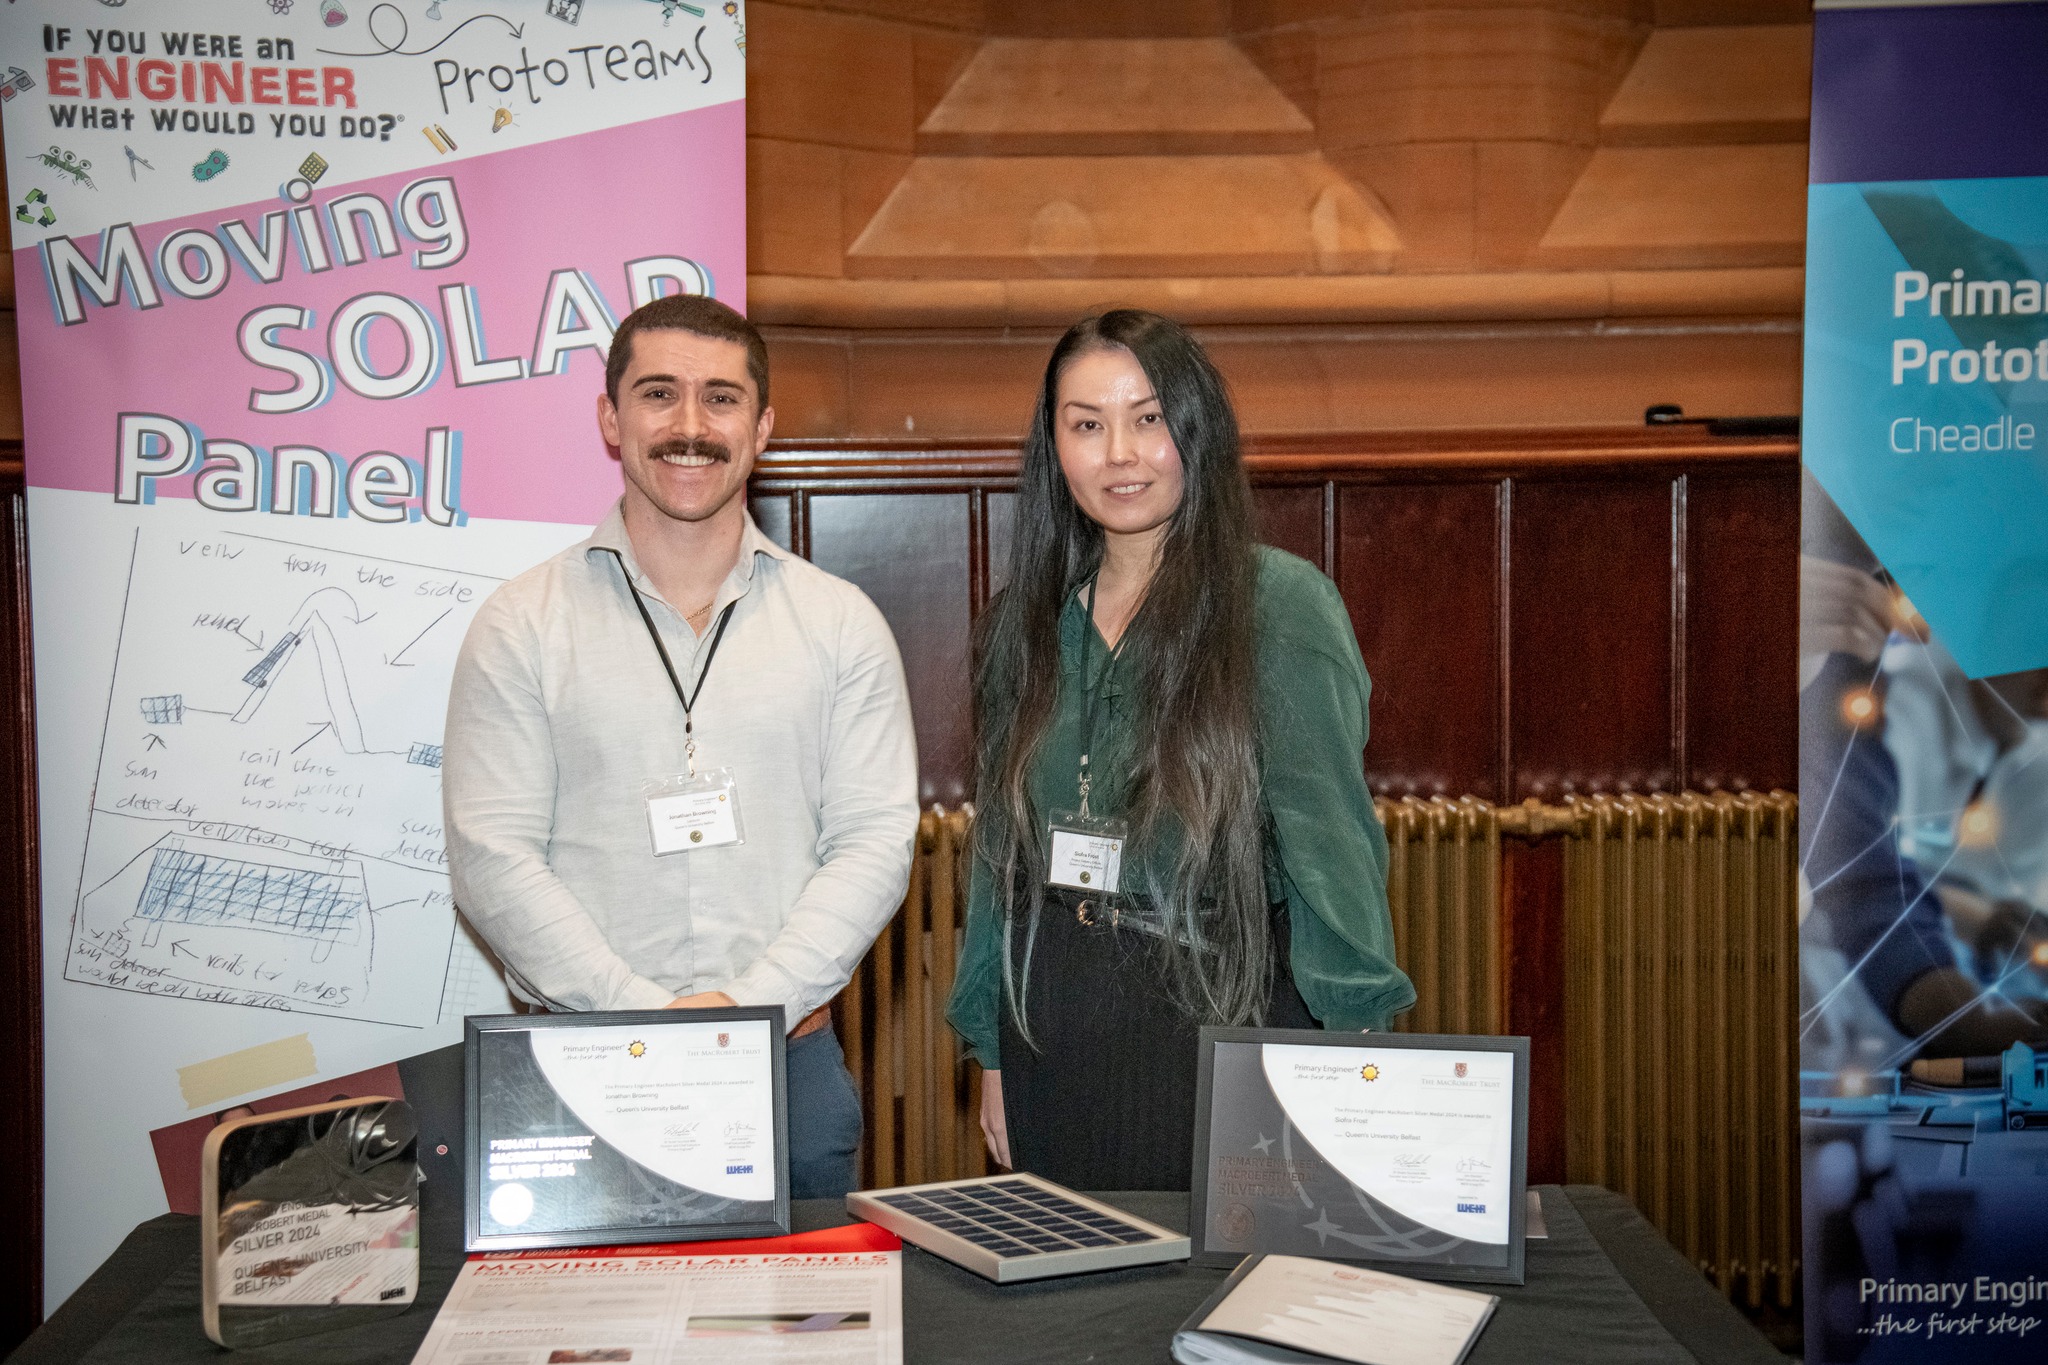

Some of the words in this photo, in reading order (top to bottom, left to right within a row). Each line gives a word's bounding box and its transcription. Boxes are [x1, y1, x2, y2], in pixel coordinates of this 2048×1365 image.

[43, 24, 72, 52] IF
[86, 28, 146, 54] YOU
[161, 31, 244, 58] WERE
[256, 37, 295, 60] an
[46, 56, 358, 109] ENGINEER
[151, 107, 256, 135] WOULD
[270, 112, 326, 138] YOU
[38, 176, 470, 325] Moving
[1890, 415, 2035, 453] Cheadle
[113, 412, 470, 528] Panel
[283, 554, 327, 577] from
[357, 565, 397, 588] the
[414, 581, 474, 603] side
[563, 1045, 590, 1054] Primary
[1294, 1063, 1321, 1073] Primary
[1323, 1065, 1355, 1074] Engineer
[1345, 1130, 1369, 1138] Queen's
[1370, 1132, 1400, 1140] University
[1218, 1156, 1266, 1167] PRIMARY
[297, 1208, 331, 1222] MEDAL
[234, 1232, 284, 1254] SILVER
[289, 1223, 321, 1243] 2024
[296, 1240, 371, 1264] UNIVERSITY
[476, 1260, 625, 1272] MOVING
[637, 1258, 750, 1267] SOLAR
[762, 1254, 889, 1264] PANELS
[234, 1276, 292, 1296] BELFAST
[1859, 1277, 1968, 1309] Primary
[1974, 1275, 2048, 1308] Engin
[1926, 1312, 1983, 1340] first
[1987, 1311, 2042, 1338] step
